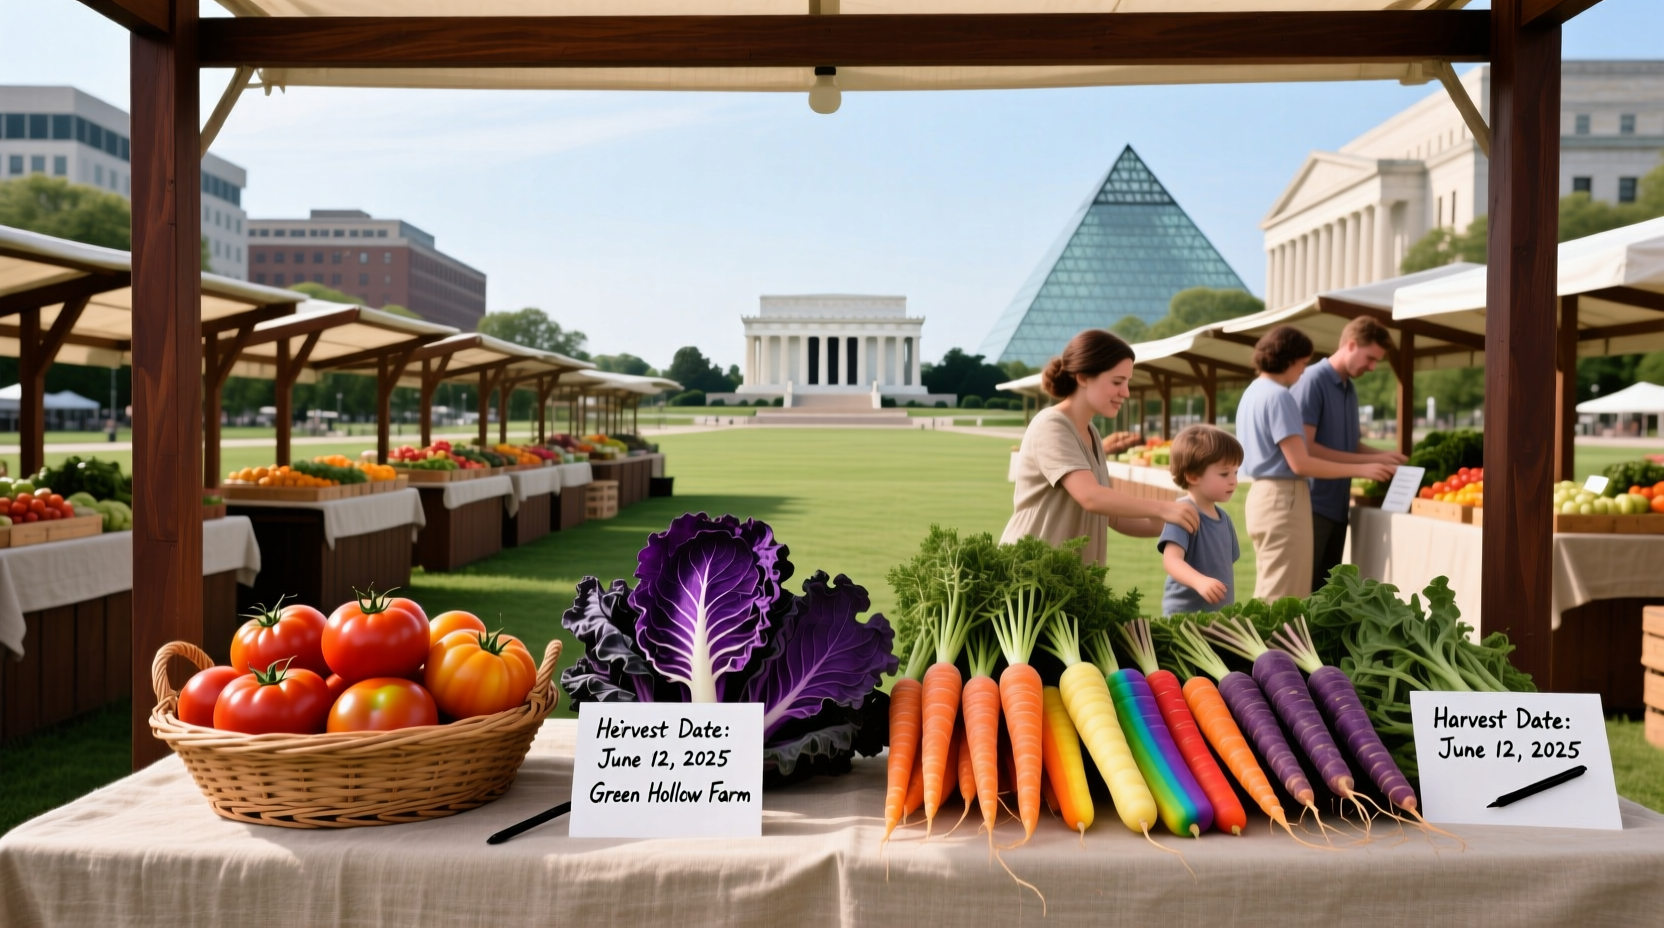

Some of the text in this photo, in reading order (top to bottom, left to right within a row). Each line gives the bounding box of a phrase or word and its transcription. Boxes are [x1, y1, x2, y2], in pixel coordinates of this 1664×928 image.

[678, 717, 730, 739] Date:
[1433, 705, 1570, 730] Harvest Date:
[597, 747, 732, 771] June 12, 2025
[1438, 736, 1582, 763] June 12, 2025
[589, 780, 751, 804] Green Hollow Farm
